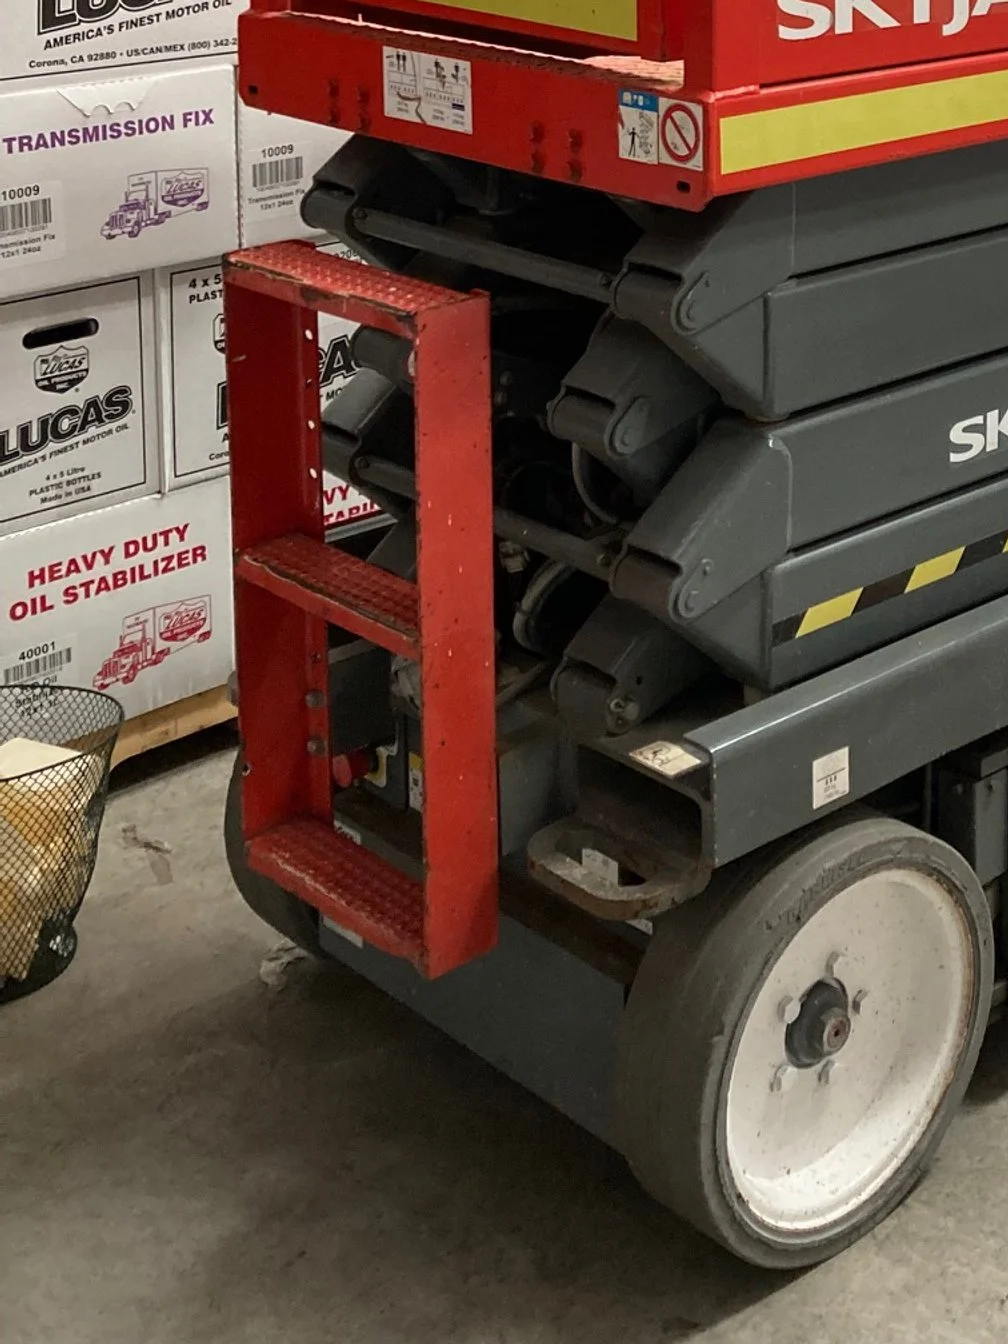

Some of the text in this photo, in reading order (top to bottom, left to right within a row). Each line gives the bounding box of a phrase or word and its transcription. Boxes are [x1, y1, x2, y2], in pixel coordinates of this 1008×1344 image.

[43, 24, 115, 51] AMERICA'S
[118, 12, 162, 33] FINEST
[165, 1, 210, 21] MOTOR
[29, 57, 68, 69] Corona,
[70, 55, 84, 64] CA
[87, 51, 117, 63] 92880
[187, 41, 211, 52] (800)
[213, 37, 238, 48] 342-2
[2, 108, 215, 154] TRANSMISSION FIX
[261, 144, 294, 158] 10009
[2, 184, 40, 201] 10009
[188, 274, 222, 289] 4 x 5
[189, 289, 223, 304] PLAST
[42, 357, 85, 376] LUCAS
[0, 385, 133, 466] LUCAS
[49, 442, 80, 459] FINEST
[82, 430, 114, 446] MOTOR
[115, 423, 129, 434] OIL
[66, 466, 85, 477] Litre
[29, 472, 102, 496] PLASTIC BOTTLES
[40, 485, 92, 504] Made in USA
[28, 523, 189, 588] HEAVY DUTY
[9, 544, 207, 622] OIL STABILIZER
[164, 609, 206, 630] LUCAS
[19, 641, 55, 660] 40001
